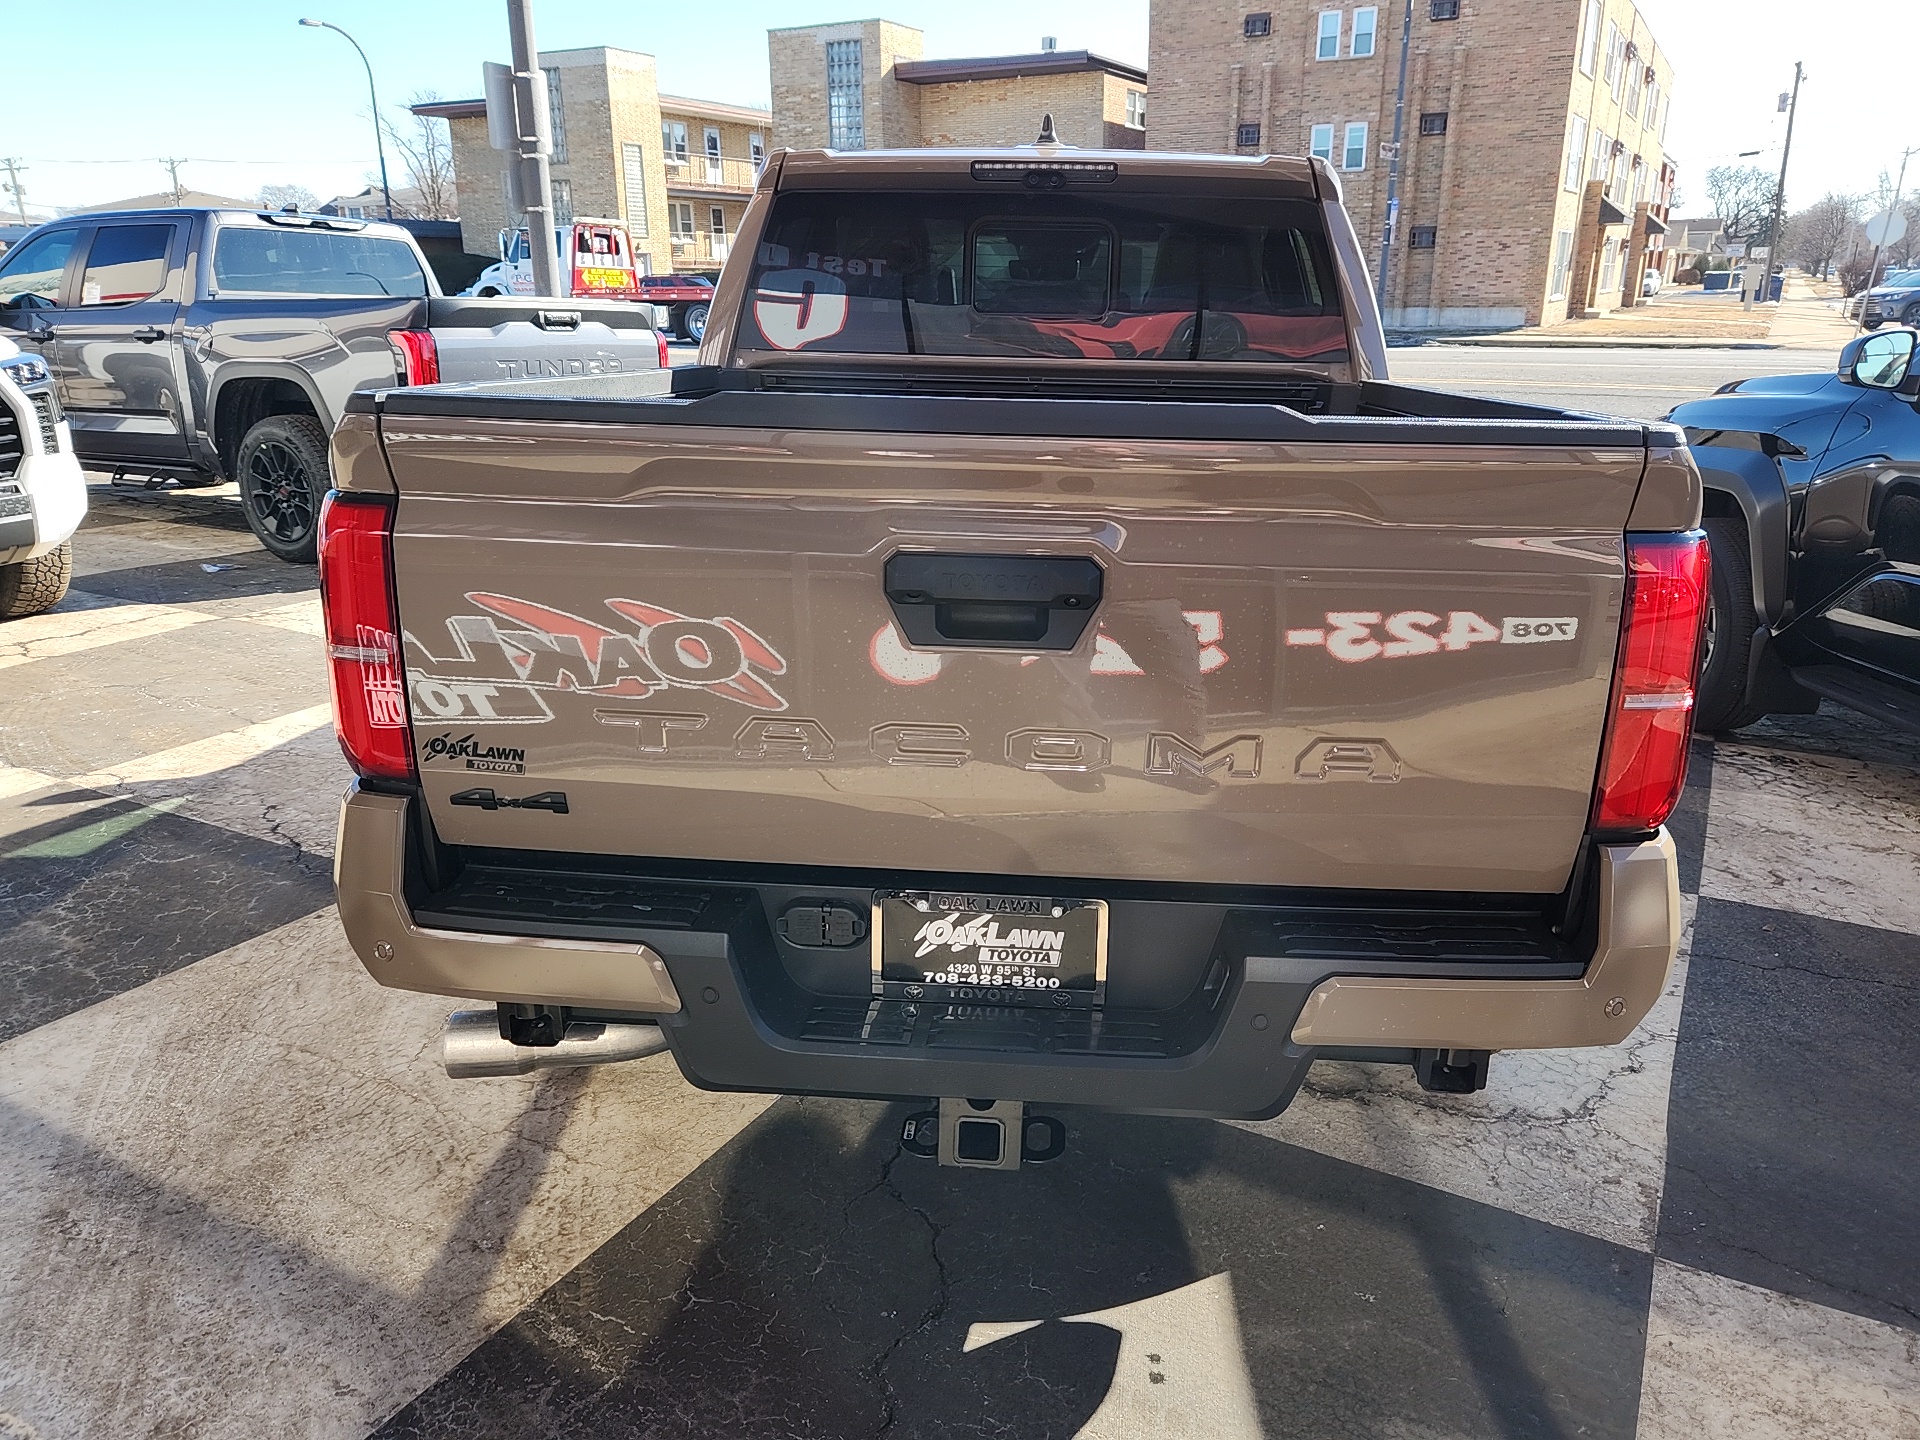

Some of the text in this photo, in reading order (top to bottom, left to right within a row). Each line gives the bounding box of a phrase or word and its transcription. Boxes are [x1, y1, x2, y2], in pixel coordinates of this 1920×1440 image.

[496, 359, 623, 379] TUNDRA
[593, 708, 1402, 784] TACOMA
[472, 760, 518, 773] TOYOTA
[937, 896, 1042, 914] OAK LAWN
[988, 949, 1051, 963] TOYOTA
[946, 963, 1037, 977] 4320 W 95th St
[923, 971, 1060, 989] 708-423-5200
[947, 987, 1027, 1003] TOYOTA
